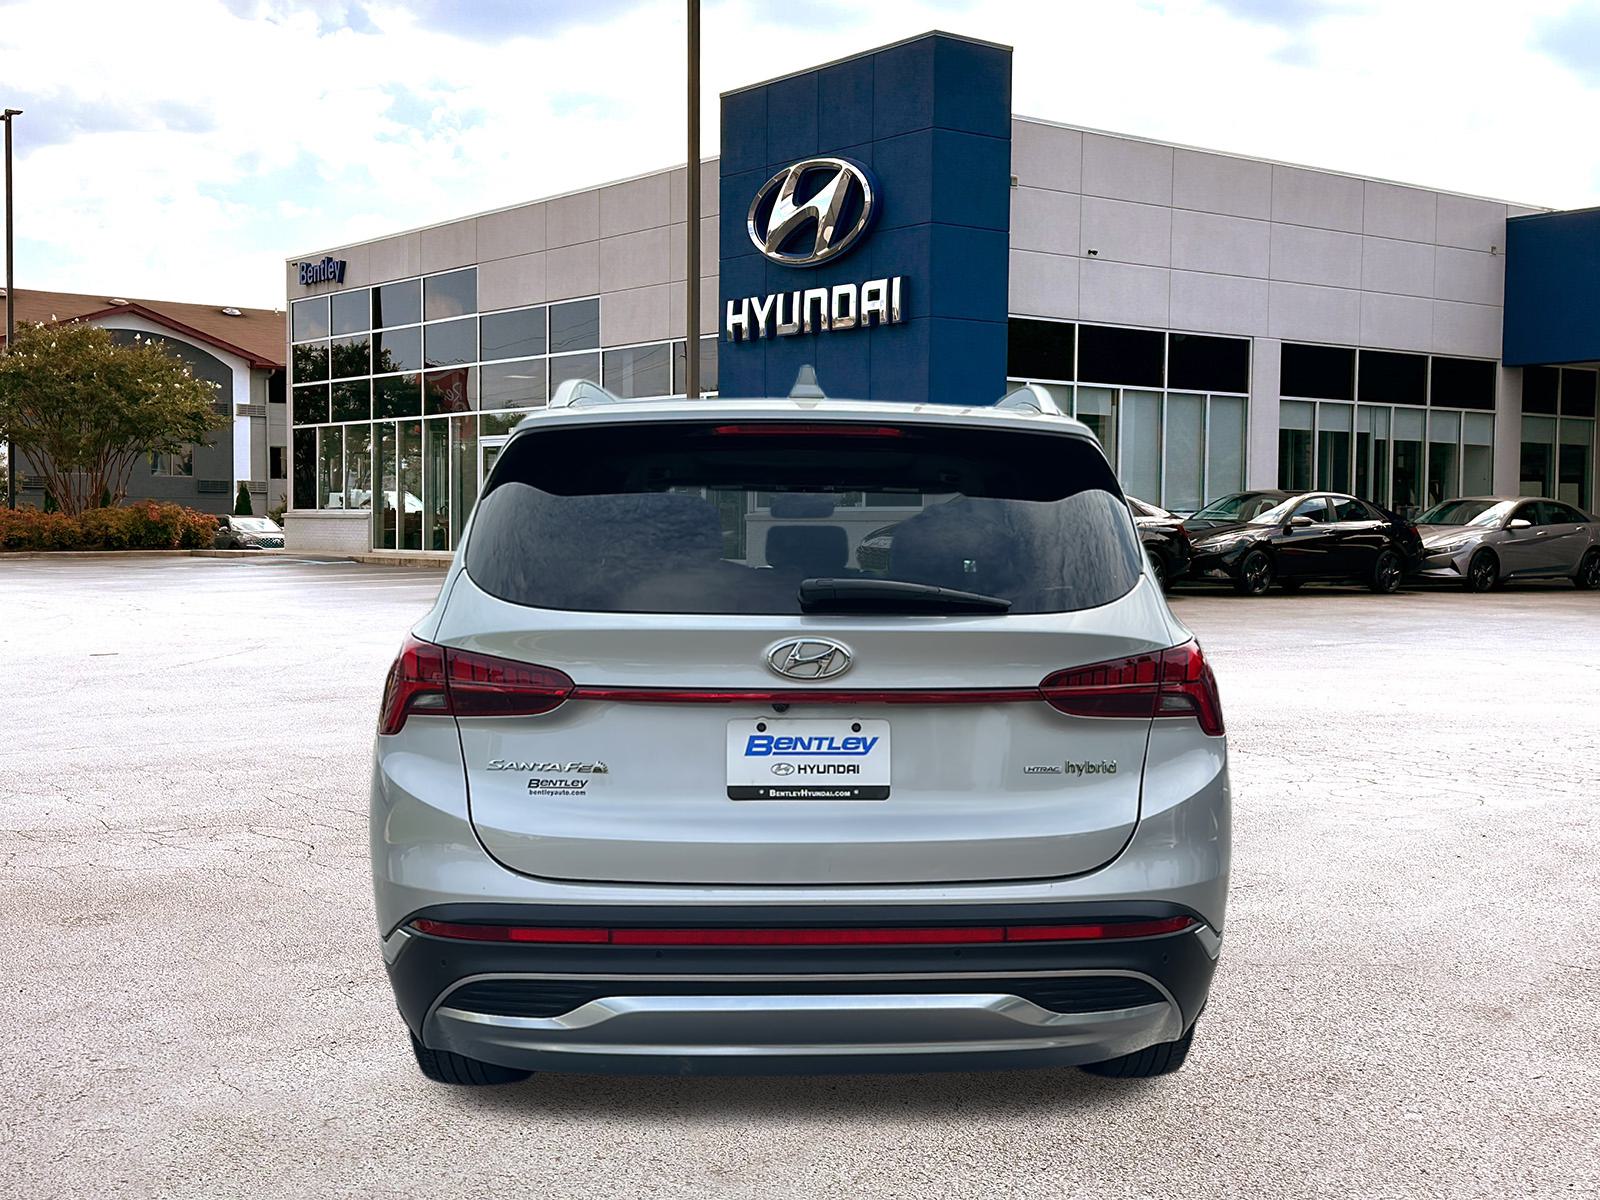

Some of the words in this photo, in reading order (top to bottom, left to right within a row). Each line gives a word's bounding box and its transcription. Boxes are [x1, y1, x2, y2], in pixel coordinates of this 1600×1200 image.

[299, 256, 346, 285] Bentley
[727, 276, 902, 342] HYUNDAI
[486, 759, 561, 772] SANTA
[797, 764, 860, 775] HYUNDAI
[1064, 760, 1117, 777] hybrid
